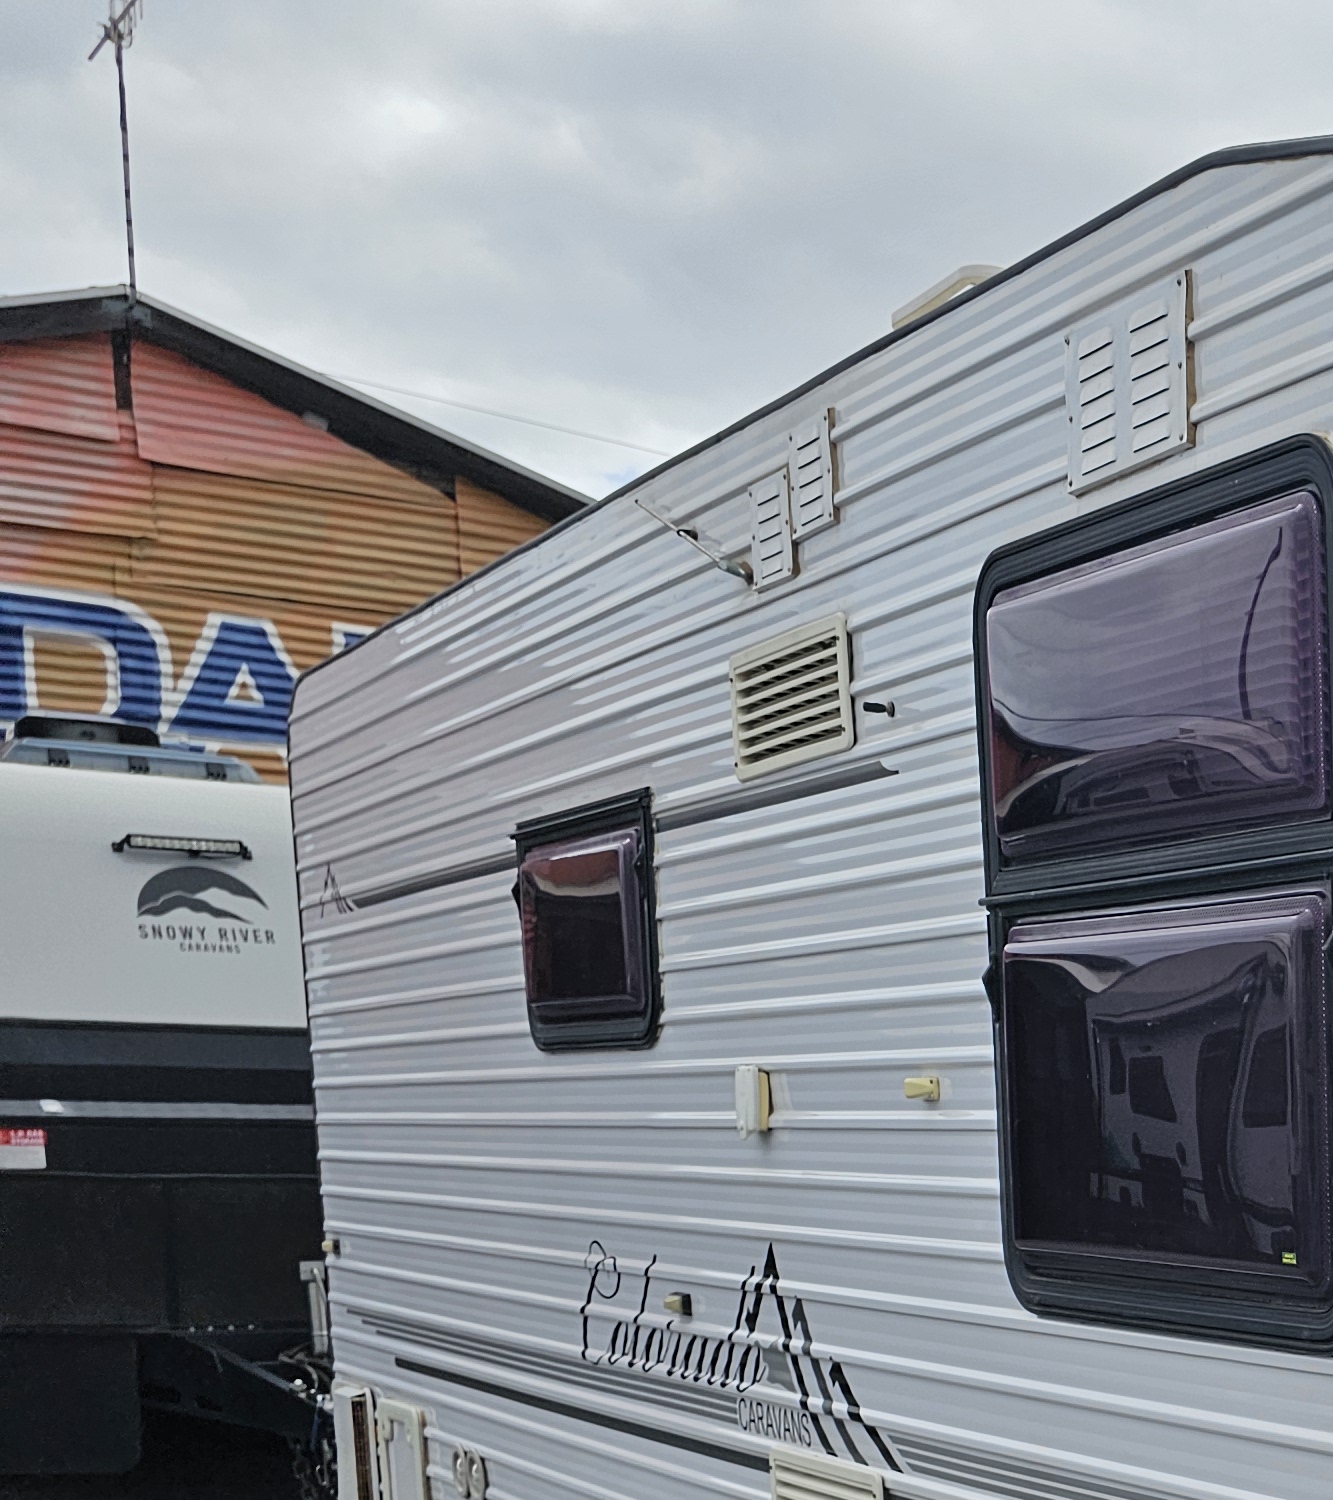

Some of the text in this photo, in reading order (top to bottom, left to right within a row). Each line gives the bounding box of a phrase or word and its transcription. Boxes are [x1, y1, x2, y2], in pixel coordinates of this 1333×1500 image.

[0, 583, 376, 748] DA
[138, 924, 276, 945] SNOWY RIVER
[179, 942, 241, 954] CARAVANS
[580, 1240, 767, 1393] Colorado
[736, 1397, 812, 1447] CARAVANS
